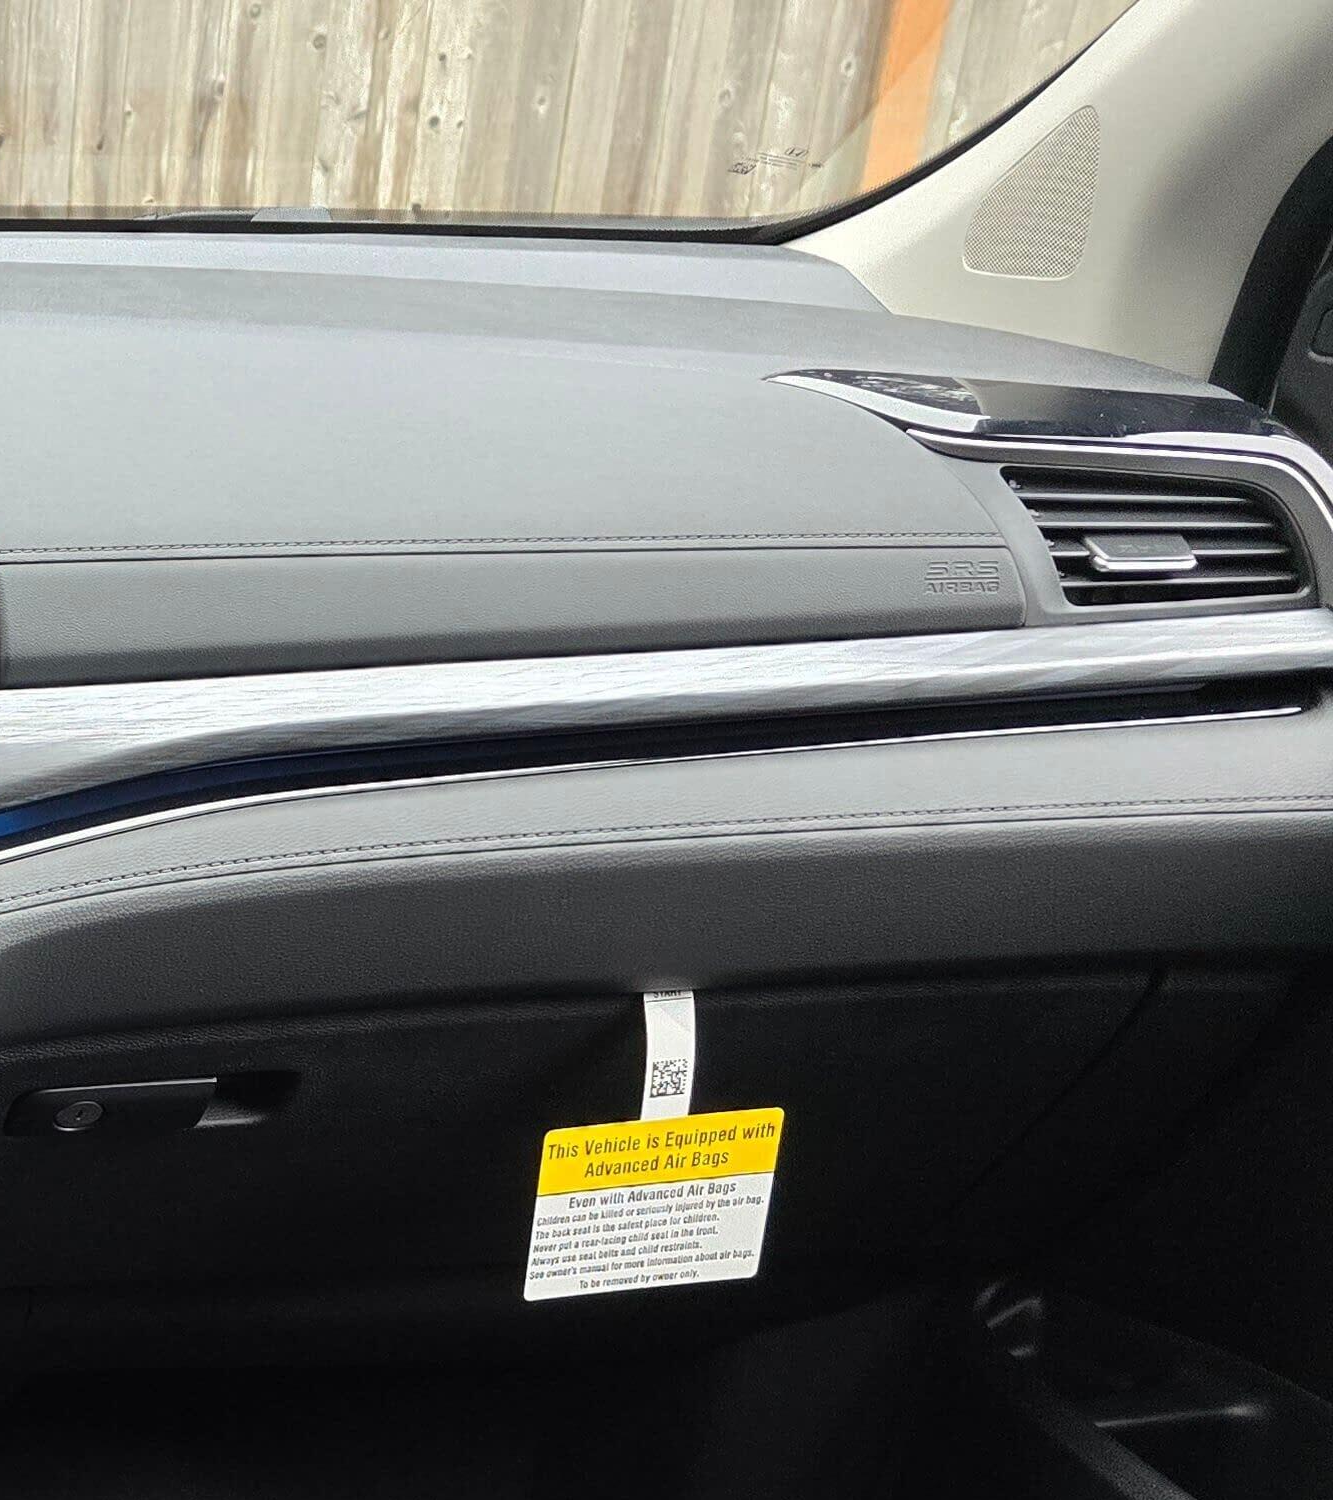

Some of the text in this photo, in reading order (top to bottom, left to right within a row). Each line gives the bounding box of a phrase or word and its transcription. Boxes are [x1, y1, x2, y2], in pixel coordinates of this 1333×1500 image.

[926, 560, 1000, 577] SRS
[924, 581, 1000, 594] AIRBAG
[548, 1122, 775, 1160] This Vehicle is Equipped with
[584, 1150, 730, 1178] Advanced Air Bags
[569, 1182, 737, 1209] Even with Advanced Air Bags
[537, 1195, 764, 1227] Children can be killed or seriously injured by the air bag.
[535, 1213, 720, 1240] The back seat is the safest place for children.
[579, 1280, 589, 1289] To
[591, 1278, 601, 1288] be
[603, 1274, 639, 1286] removed
[641, 1273, 651, 1284] by
